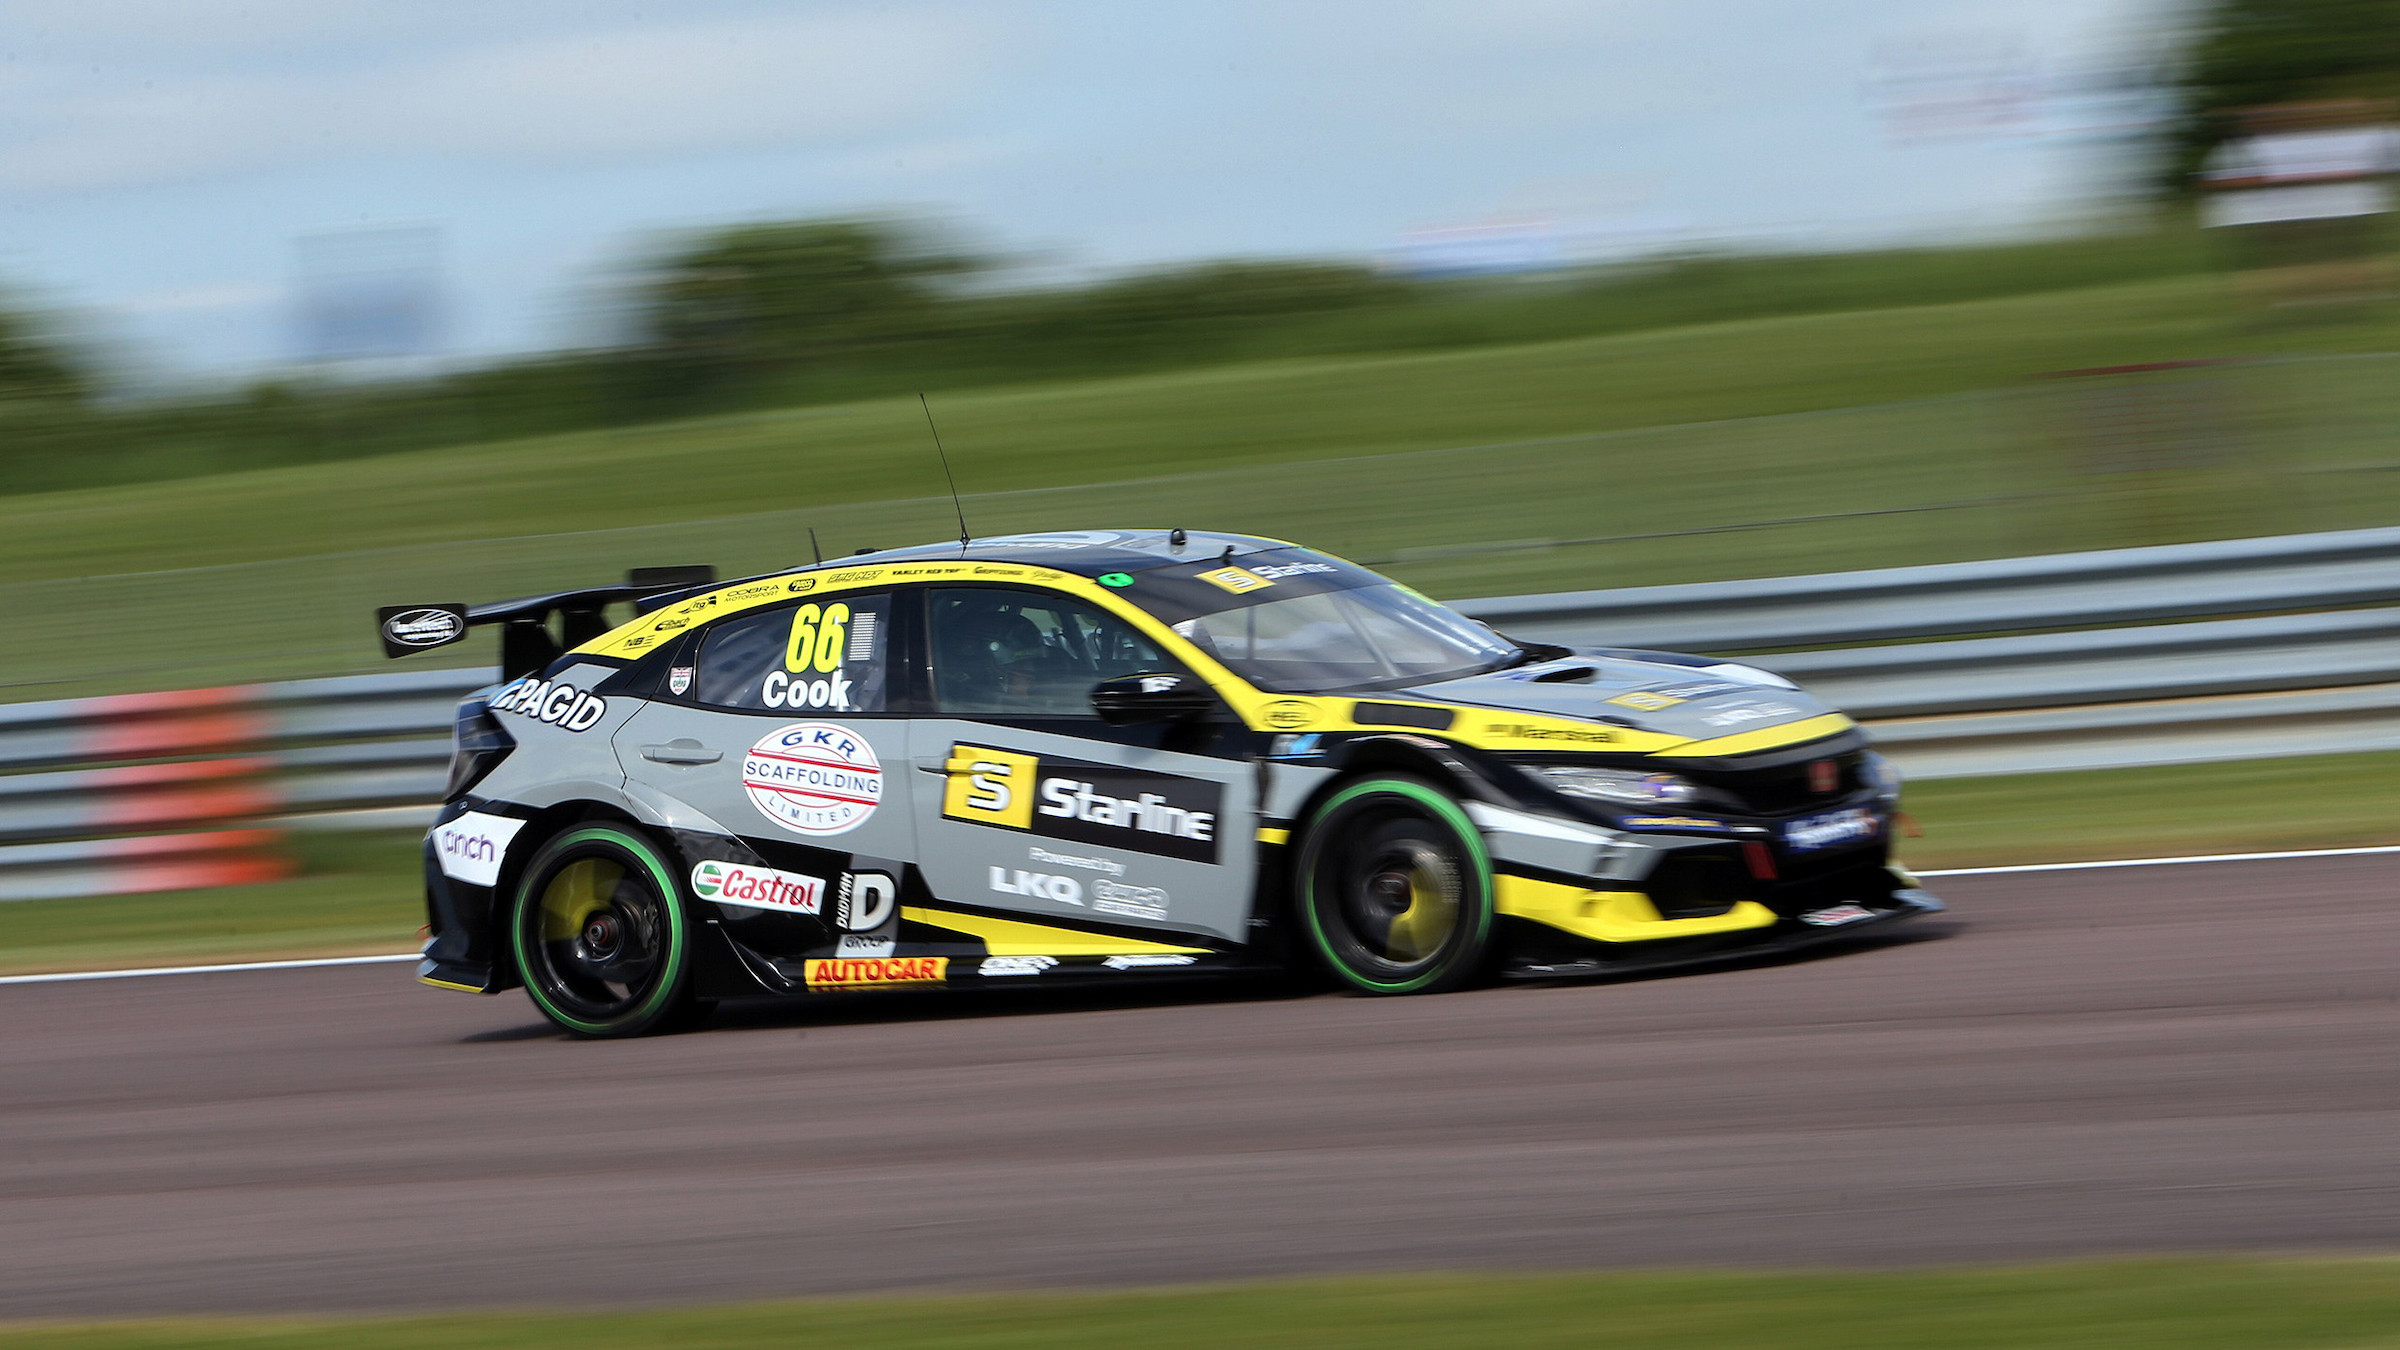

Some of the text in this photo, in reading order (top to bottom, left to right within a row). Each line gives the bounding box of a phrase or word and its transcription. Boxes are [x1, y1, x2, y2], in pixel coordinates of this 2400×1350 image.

[724, 591, 778, 602] MOTORSPORT
[727, 585, 780, 597] COBRA
[785, 603, 849, 673] 66
[506, 679, 605, 732] PAGID
[762, 671, 853, 708] Cook
[781, 731, 856, 758] GKR
[745, 761, 880, 793] SCAFFOLDING
[769, 796, 851, 824] LIMITED
[1038, 777, 1215, 841] Starline
[443, 830, 495, 863] cinch
[723, 870, 815, 908] Castrol
[836, 871, 854, 930] DUDMAN
[849, 873, 896, 931] D
[989, 866, 1085, 907] LKQ
[845, 936, 890, 948] GROUP
[814, 958, 937, 983] AUTOCAR
